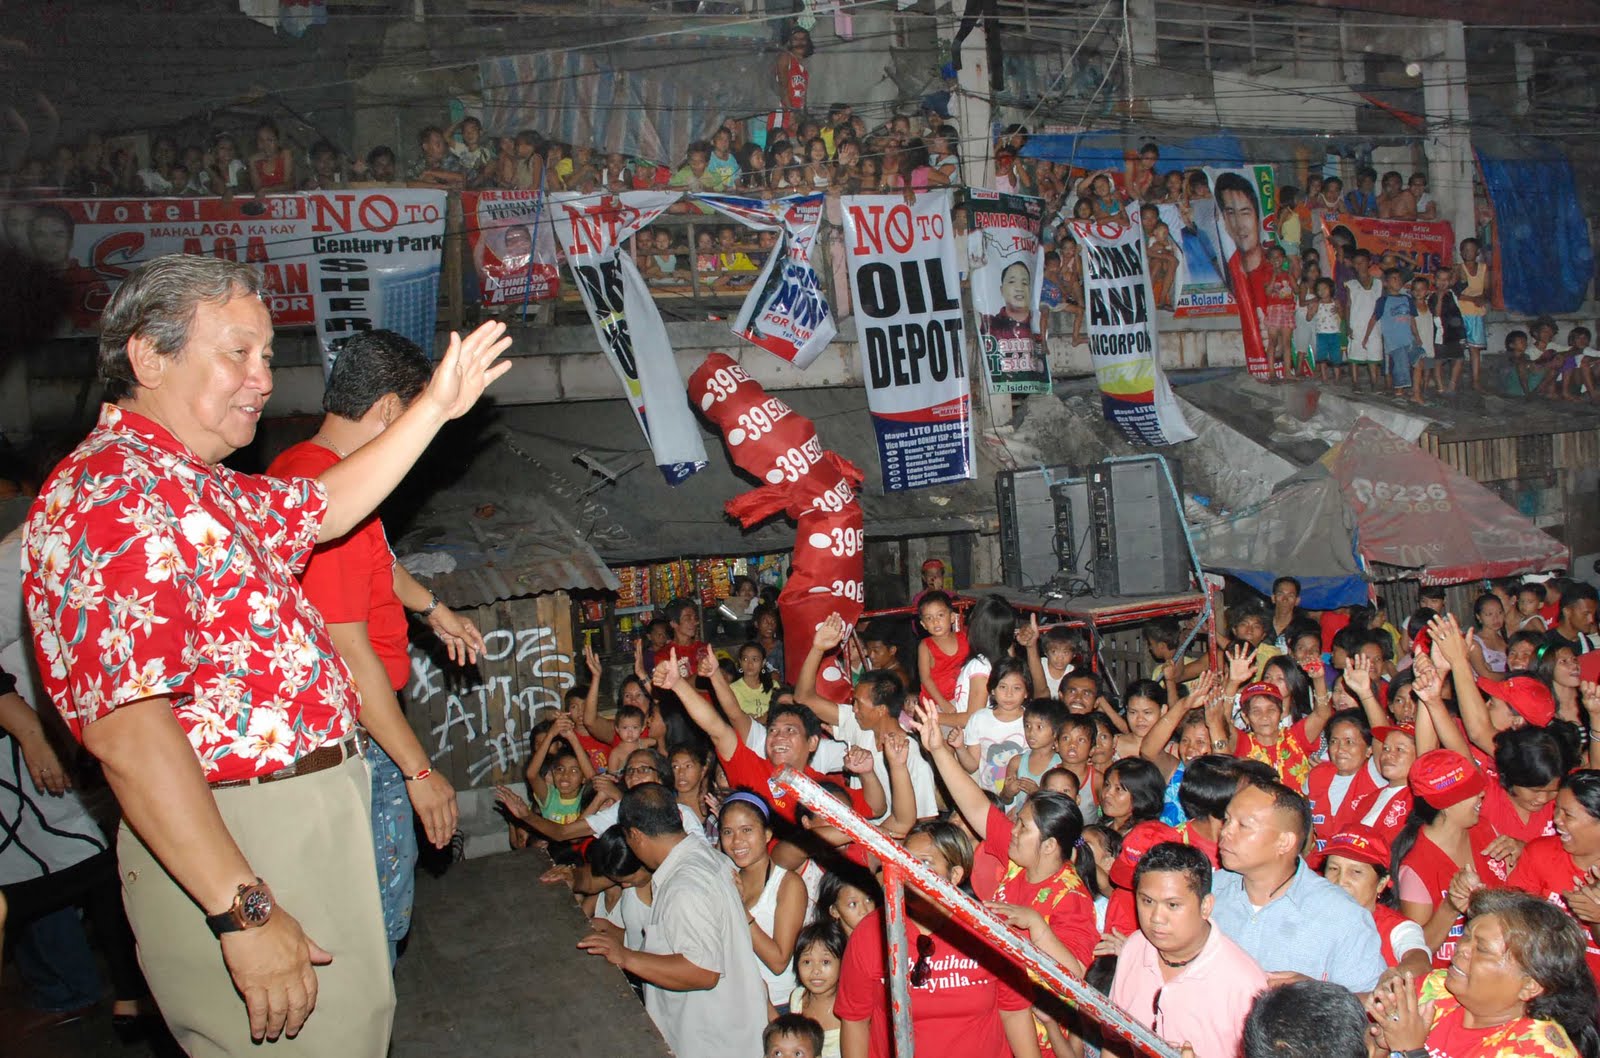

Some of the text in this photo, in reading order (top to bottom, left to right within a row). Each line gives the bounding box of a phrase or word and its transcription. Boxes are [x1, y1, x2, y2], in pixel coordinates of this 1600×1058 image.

[271, 199, 298, 219] 38
[311, 194, 439, 233] NO TO
[150, 223, 297, 238] MAHALAGA KA KAY
[313, 234, 442, 254] Century Park
[849, 204, 945, 256] NO TO
[856, 258, 960, 318] OIL
[1191, 292, 1224, 306] Roland
[763, 313, 790, 328] FOR
[865, 318, 964, 389] DEPOT
[706, 368, 738, 402] 39
[738, 406, 773, 441] 39
[884, 431, 908, 441] Mayor
[909, 425, 931, 437] LITO
[885, 442, 899, 450] Vice
[899, 439, 917, 449] Mayor
[775, 447, 809, 482] 39
[831, 527, 856, 557] 39
